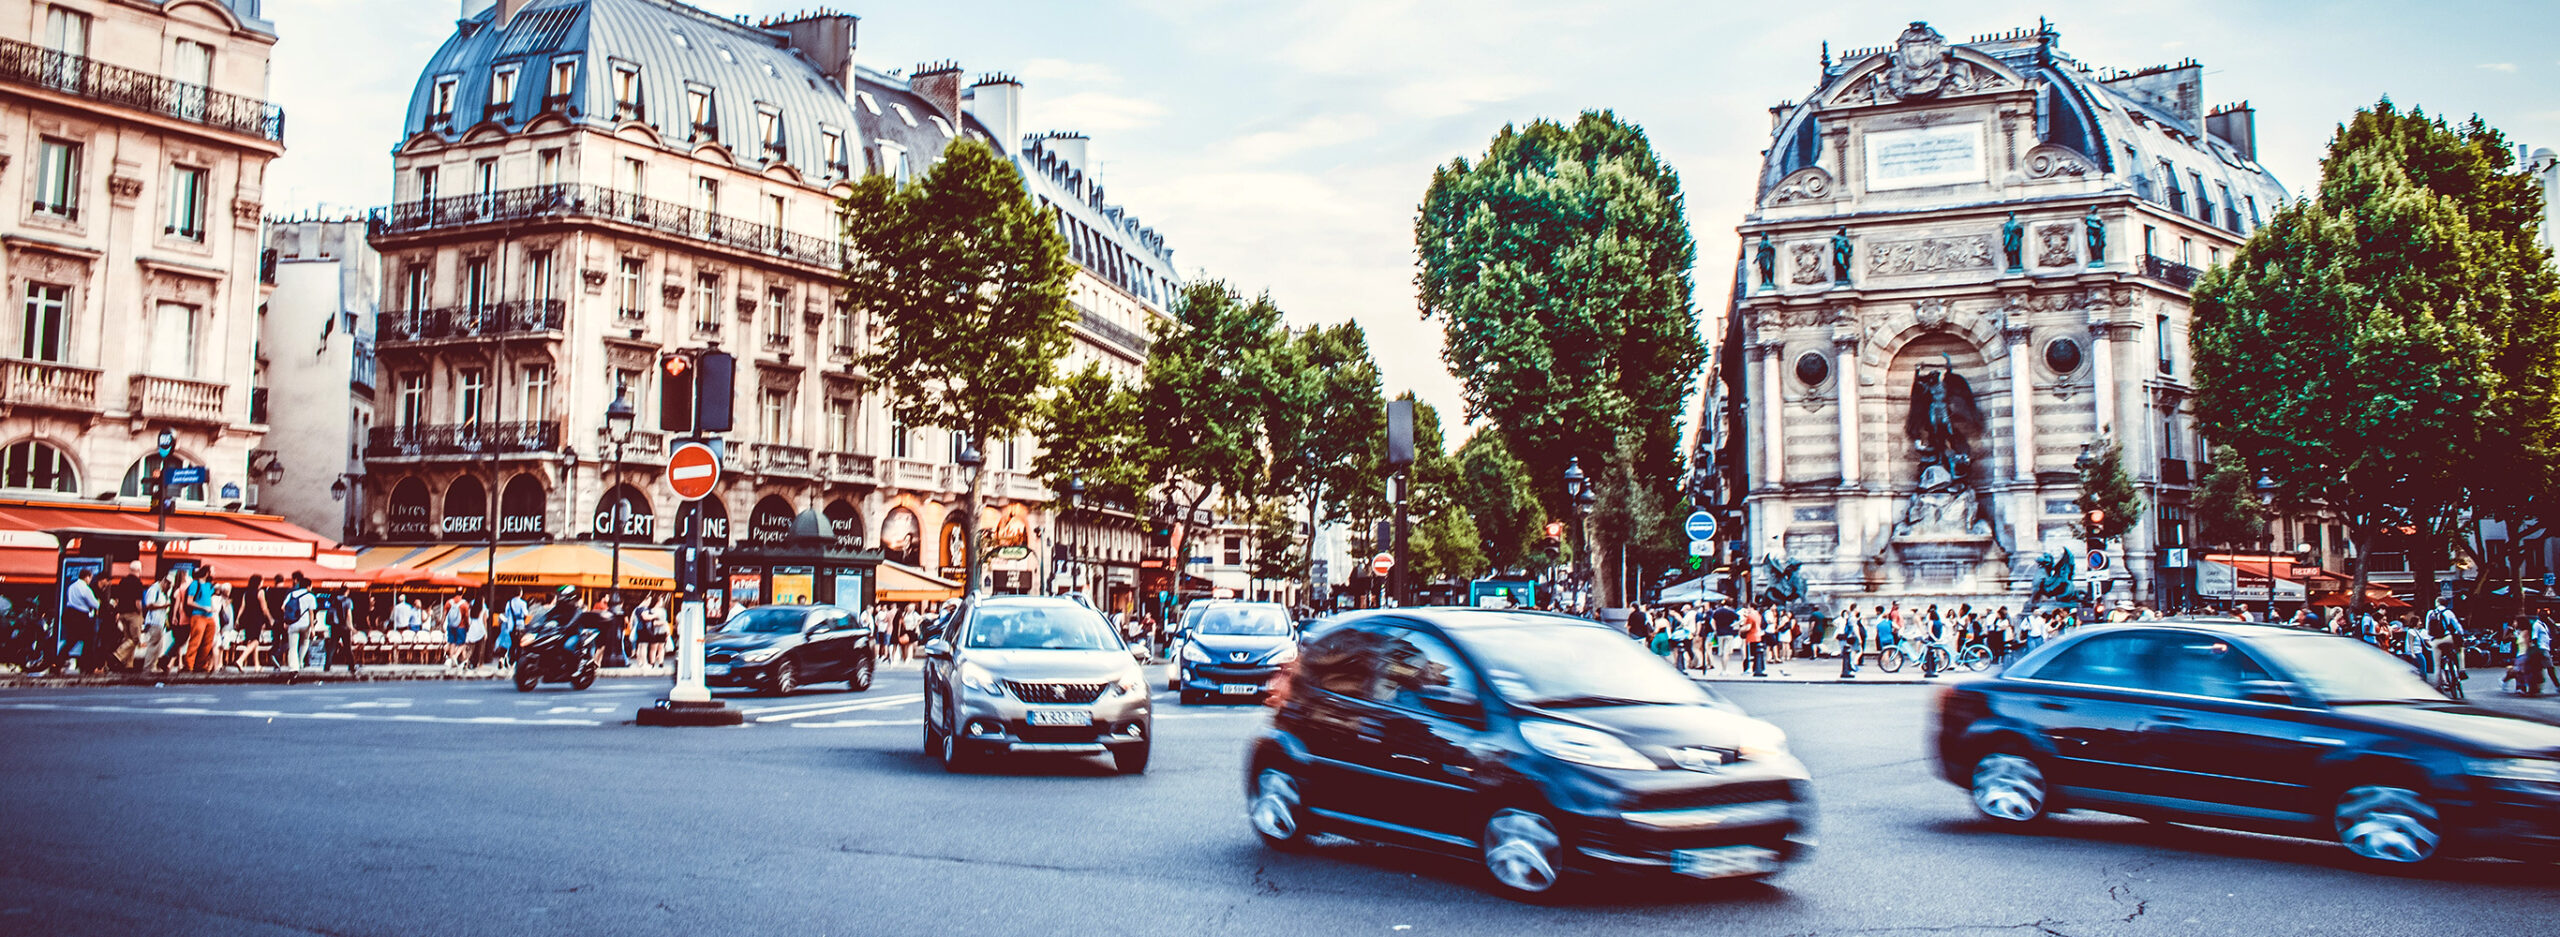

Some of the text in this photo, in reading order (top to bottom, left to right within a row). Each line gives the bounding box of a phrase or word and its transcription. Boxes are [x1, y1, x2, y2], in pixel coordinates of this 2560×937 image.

[443, 515, 543, 533] GIBERT JEUNE
[595, 512, 654, 535] GIERT
[761, 512, 793, 528] Livres
